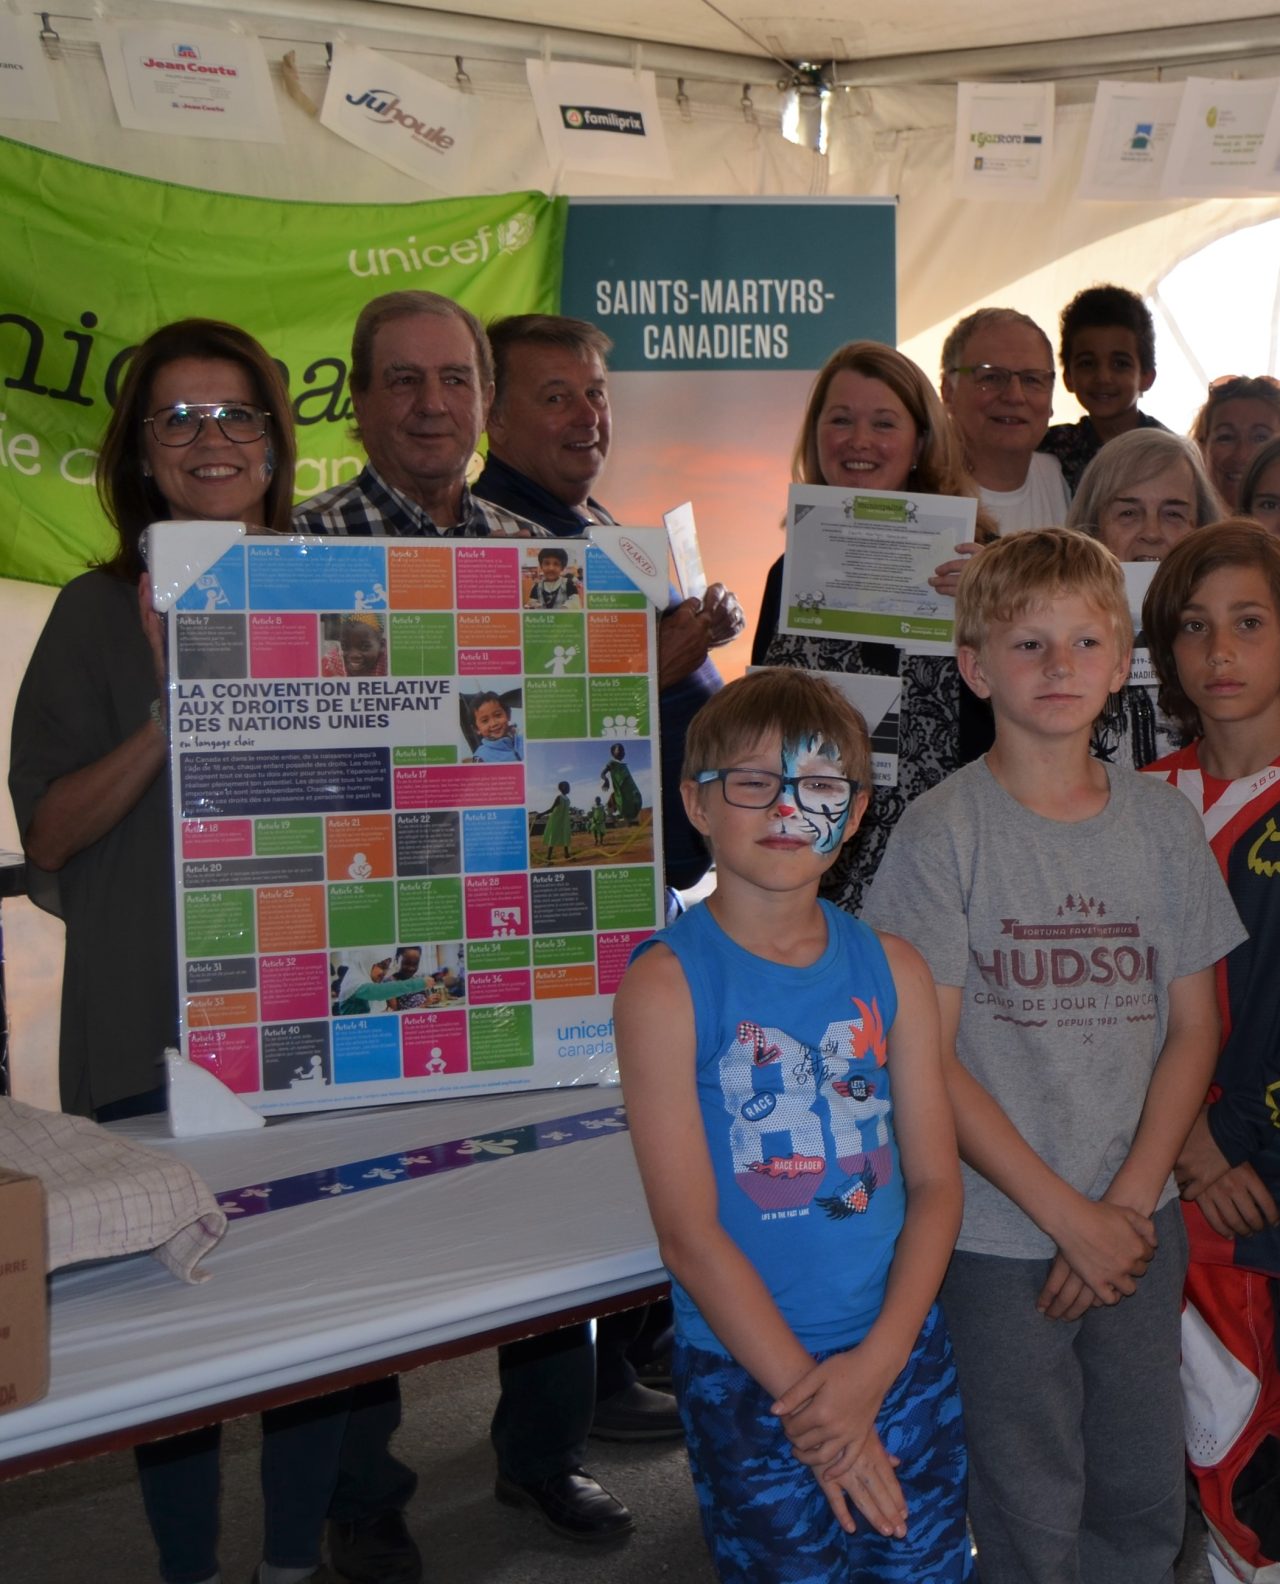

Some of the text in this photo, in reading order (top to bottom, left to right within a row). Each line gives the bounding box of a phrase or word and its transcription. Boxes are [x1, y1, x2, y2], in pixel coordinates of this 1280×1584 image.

[144, 58, 237, 77] Jean Coutu
[584, 111, 641, 131] familiprix
[349, 224, 492, 277] unicef
[596, 279, 835, 315] SAINTS-MARTYRS-
[643, 324, 789, 359] CANADIENS
[250, 548, 272, 556] Article
[458, 550, 486, 558] Article 4
[179, 617, 210, 626] Article 7
[252, 616, 274, 625] Article
[460, 653, 488, 662] Article 11
[178, 680, 450, 698] LA CONVENTION RELATIVE
[178, 701, 225, 715] AUX
[232, 699, 309, 715] DROITS
[316, 698, 343, 713] DE
[179, 714, 390, 732] DES NATIONS UNIES
[237, 763, 261, 771] chaque
[871, 760, 892, 769] -2021
[396, 770, 427, 779] Article 17
[328, 819, 350, 828] Article
[398, 815, 430, 824] Article 22
[186, 864, 222, 873] Article 20
[532, 874, 565, 884] Article 29
[597, 872, 618, 880] Article
[466, 878, 500, 888] Article 28
[259, 890, 282, 899] Article
[1023, 928, 1066, 936] FORTUNA
[1097, 926, 1133, 934] RTIBUS
[535, 940, 556, 948] Article
[189, 962, 222, 972] Article 31
[262, 957, 296, 968] Article 32
[470, 975, 503, 984] Article 36
[1022, 999, 1046, 1011] DE
[1052, 997, 1097, 1010] JOUR
[404, 1014, 438, 1025] Article 42
[1057, 1018, 1094, 1028] DEPUIS
[264, 1026, 300, 1036] Article 40
[557, 1018, 614, 1040] unicef
[558, 1040, 614, 1057] canada
[850, 1081, 865, 1089] LET'S
[852, 1089, 867, 1097] RACE
[745, 1094, 774, 1117] RACE
[774, 1160, 822, 1171] RACE LEADER
[761, 1213, 771, 1221] LIFE
[778, 1211, 786, 1219] THE
[787, 1210, 798, 1218] FAST
[799, 1208, 810, 1217] LANE
